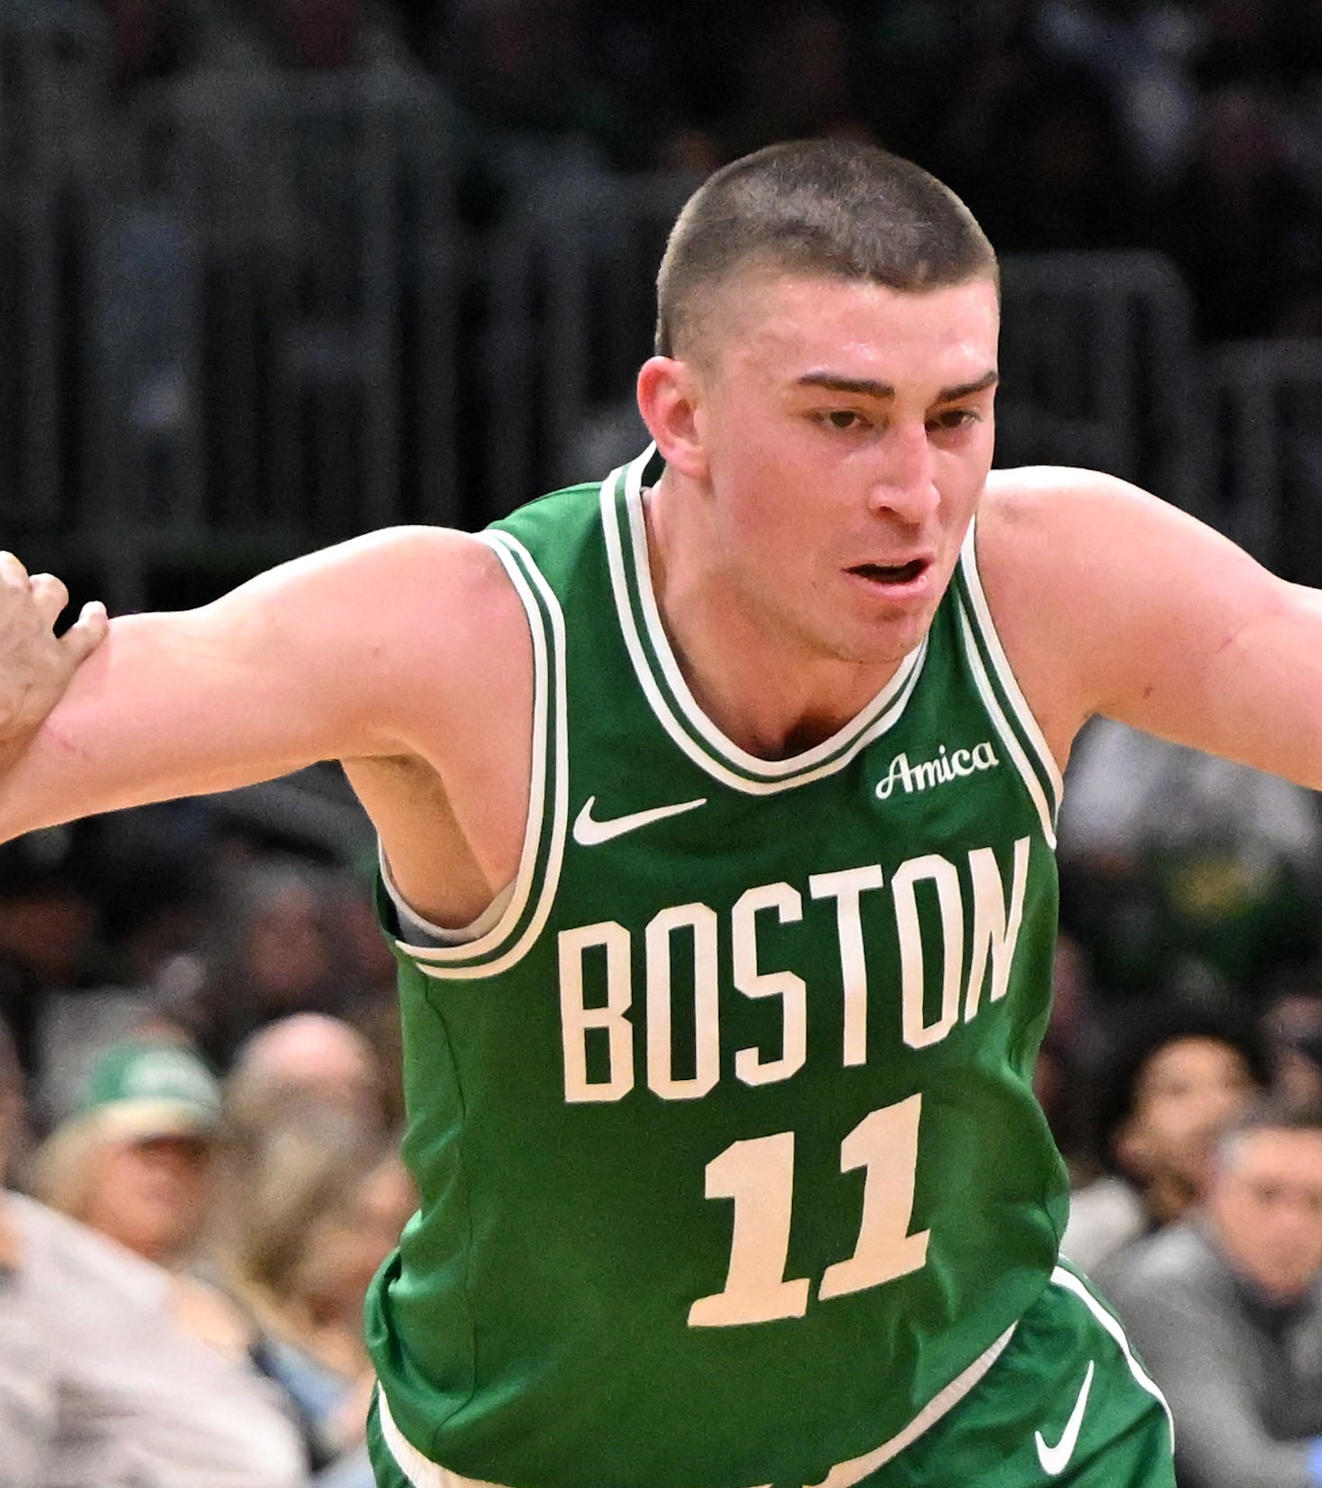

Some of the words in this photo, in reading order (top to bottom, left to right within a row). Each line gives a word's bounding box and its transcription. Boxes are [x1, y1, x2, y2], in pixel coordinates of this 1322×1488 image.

[875, 741, 999, 800] Amica
[558, 836, 1031, 1103] BOSTON
[687, 1092, 931, 1328] 11
